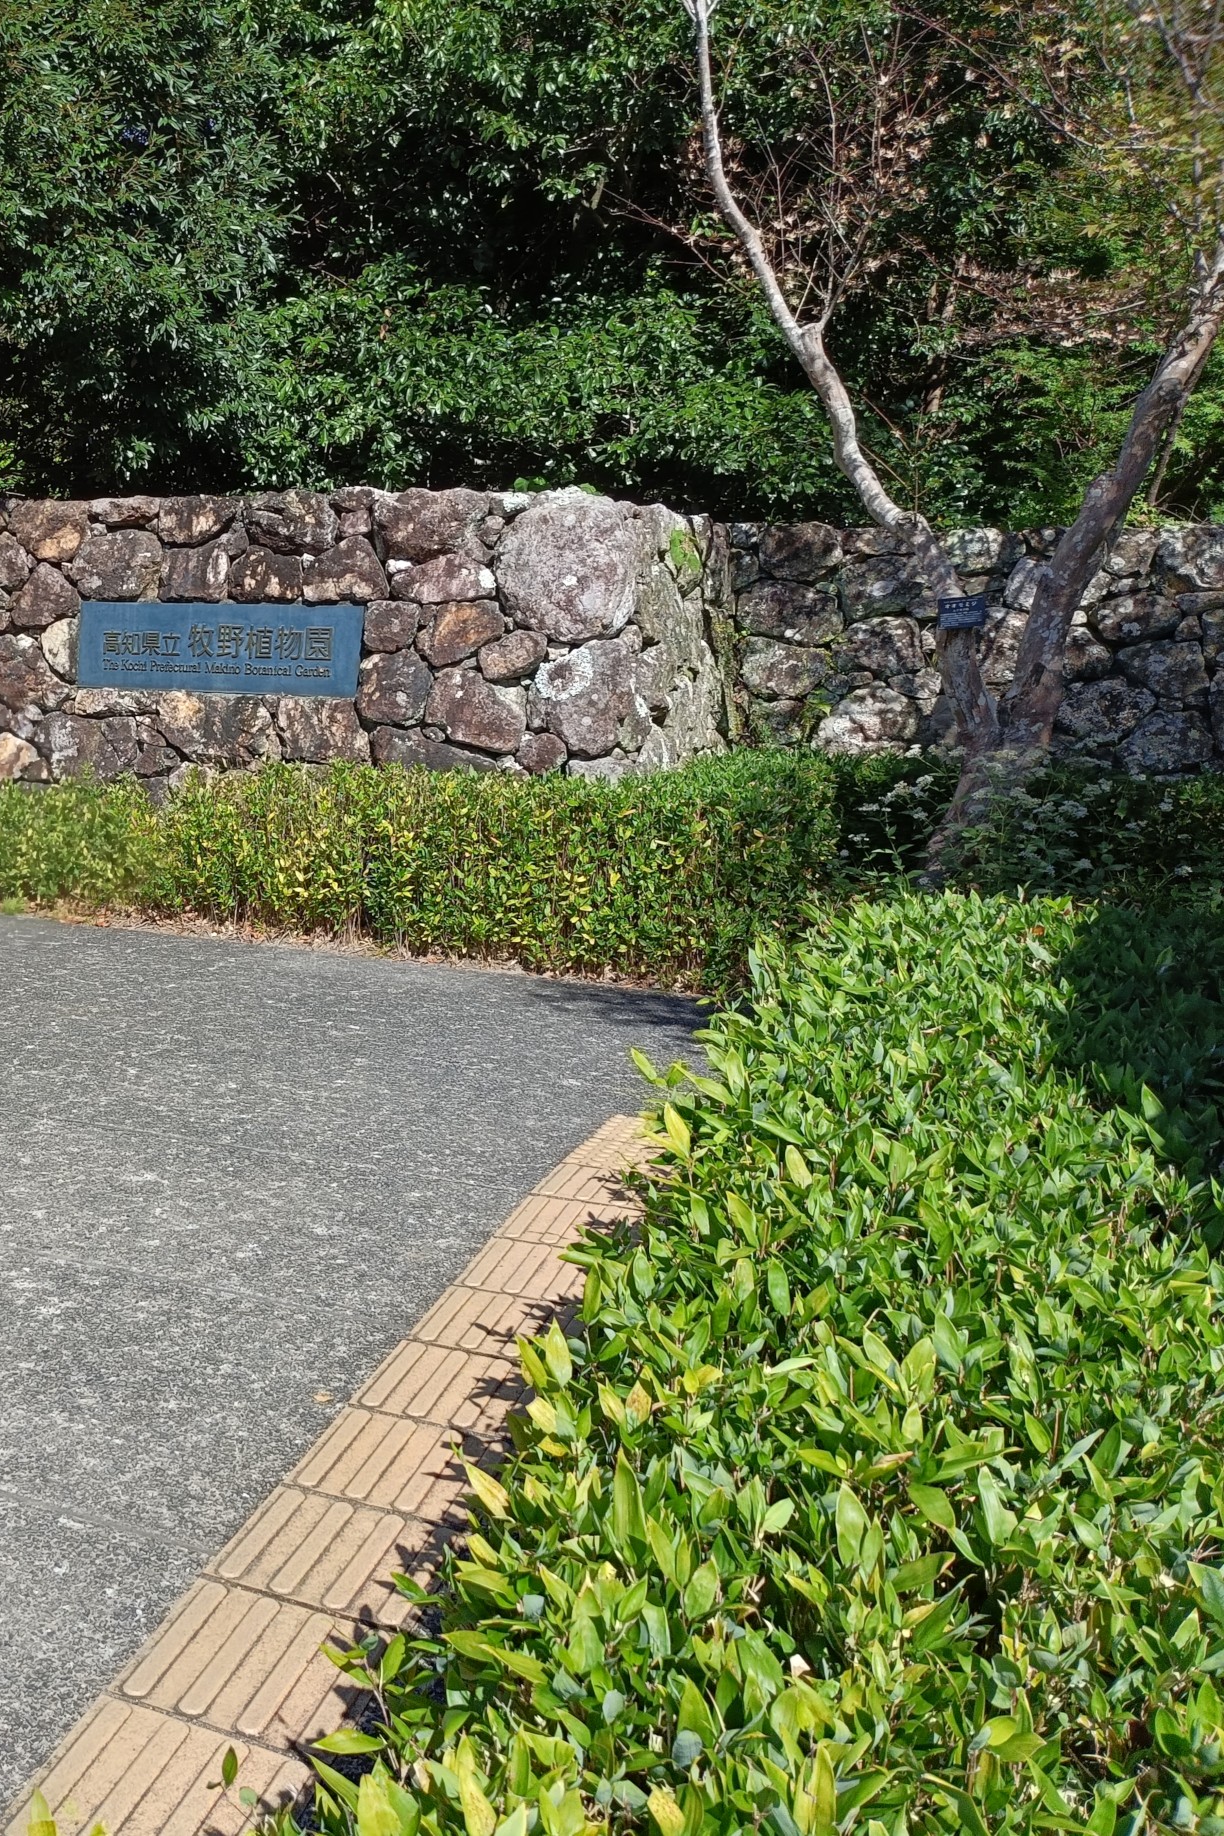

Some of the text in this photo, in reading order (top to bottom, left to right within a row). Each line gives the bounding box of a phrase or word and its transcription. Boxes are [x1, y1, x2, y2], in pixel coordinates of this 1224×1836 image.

[102, 623, 335, 661] 高知県立 牧野植物園
[102, 658, 331, 678] The Kochi Prefectural Makino Botanical Garden
